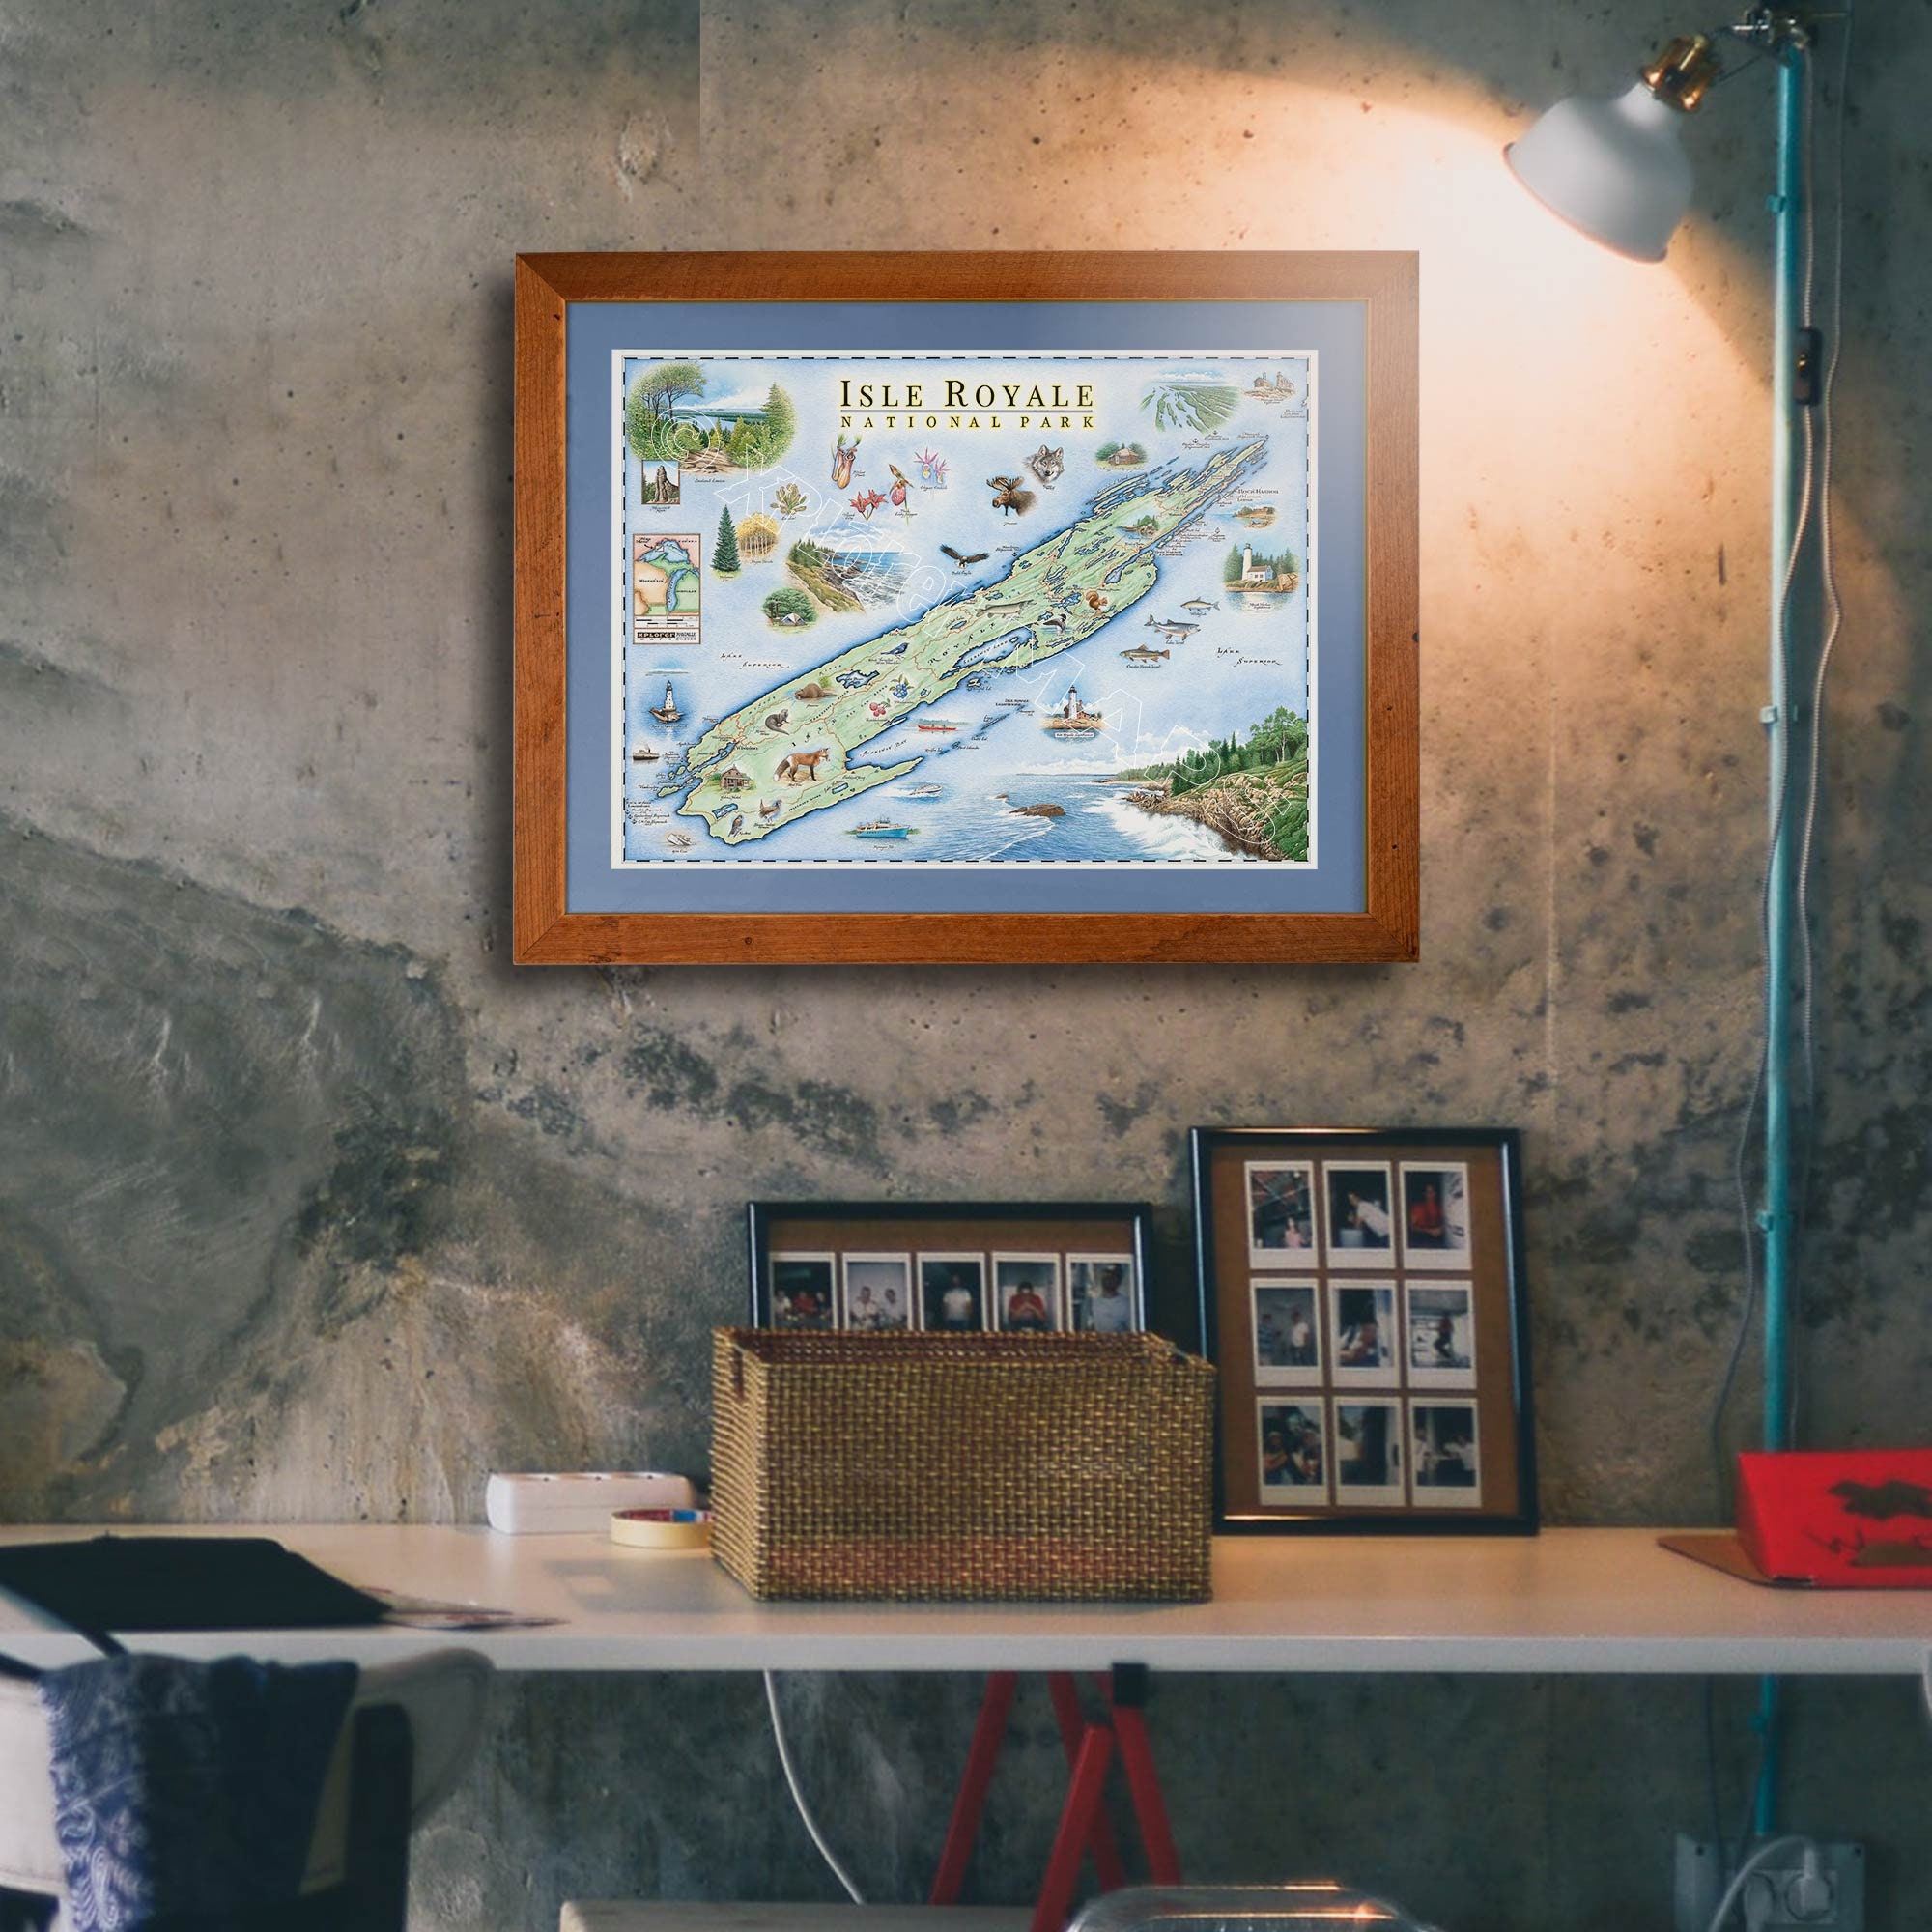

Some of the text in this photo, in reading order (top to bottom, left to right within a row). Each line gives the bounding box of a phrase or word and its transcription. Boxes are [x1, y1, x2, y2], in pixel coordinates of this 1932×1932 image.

[839, 379, 1094, 408] ISLE ROYALE
[840, 415, 1094, 429] NATIONAL PARK
